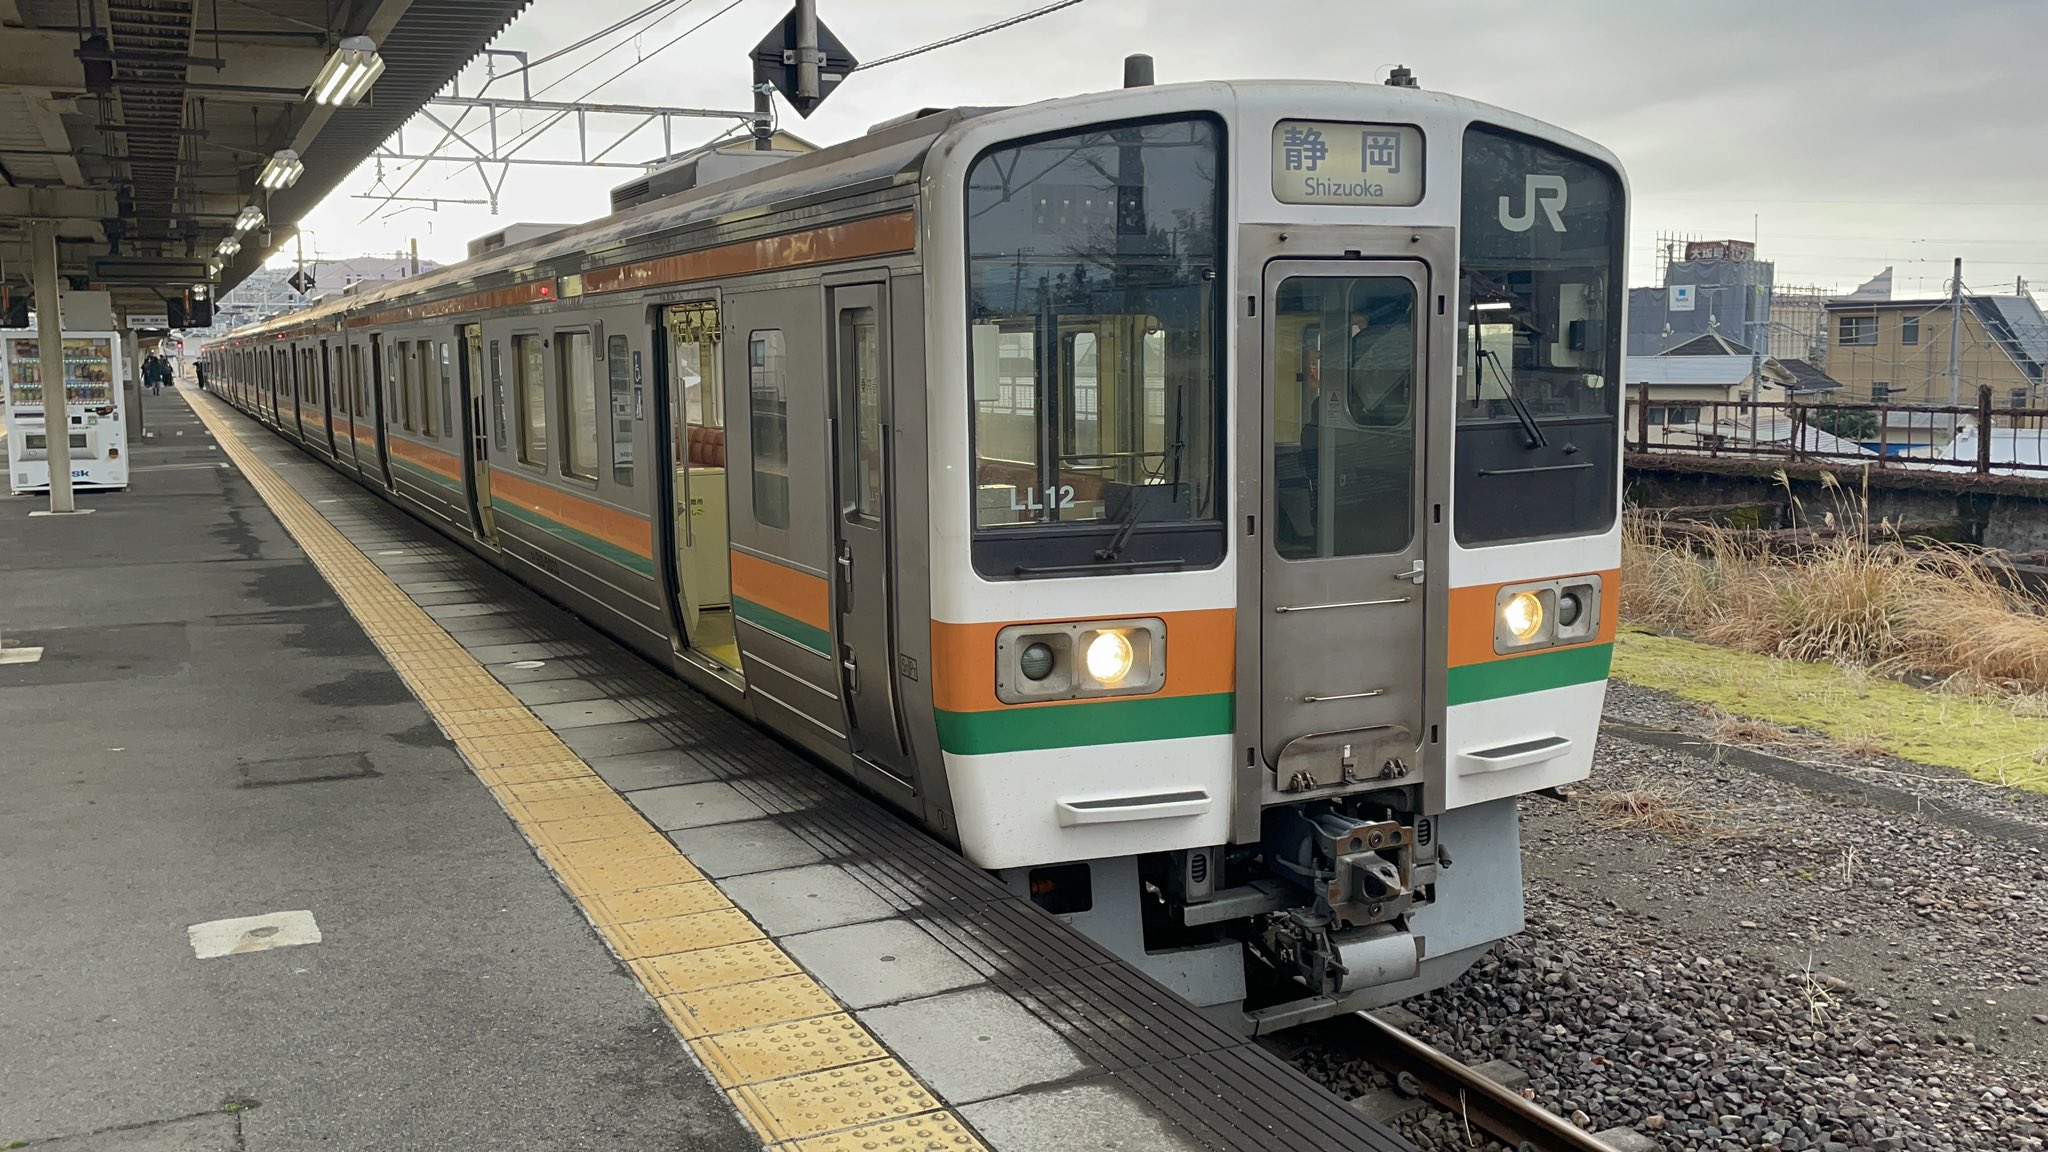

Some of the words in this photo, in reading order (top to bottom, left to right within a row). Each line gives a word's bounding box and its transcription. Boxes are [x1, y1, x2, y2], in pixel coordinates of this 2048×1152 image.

[1283, 126, 1401, 174] 静岡
[1304, 176, 1384, 197] Shizuoka
[1498, 174, 1568, 232] JR
[1010, 485, 1074, 510] LL12
